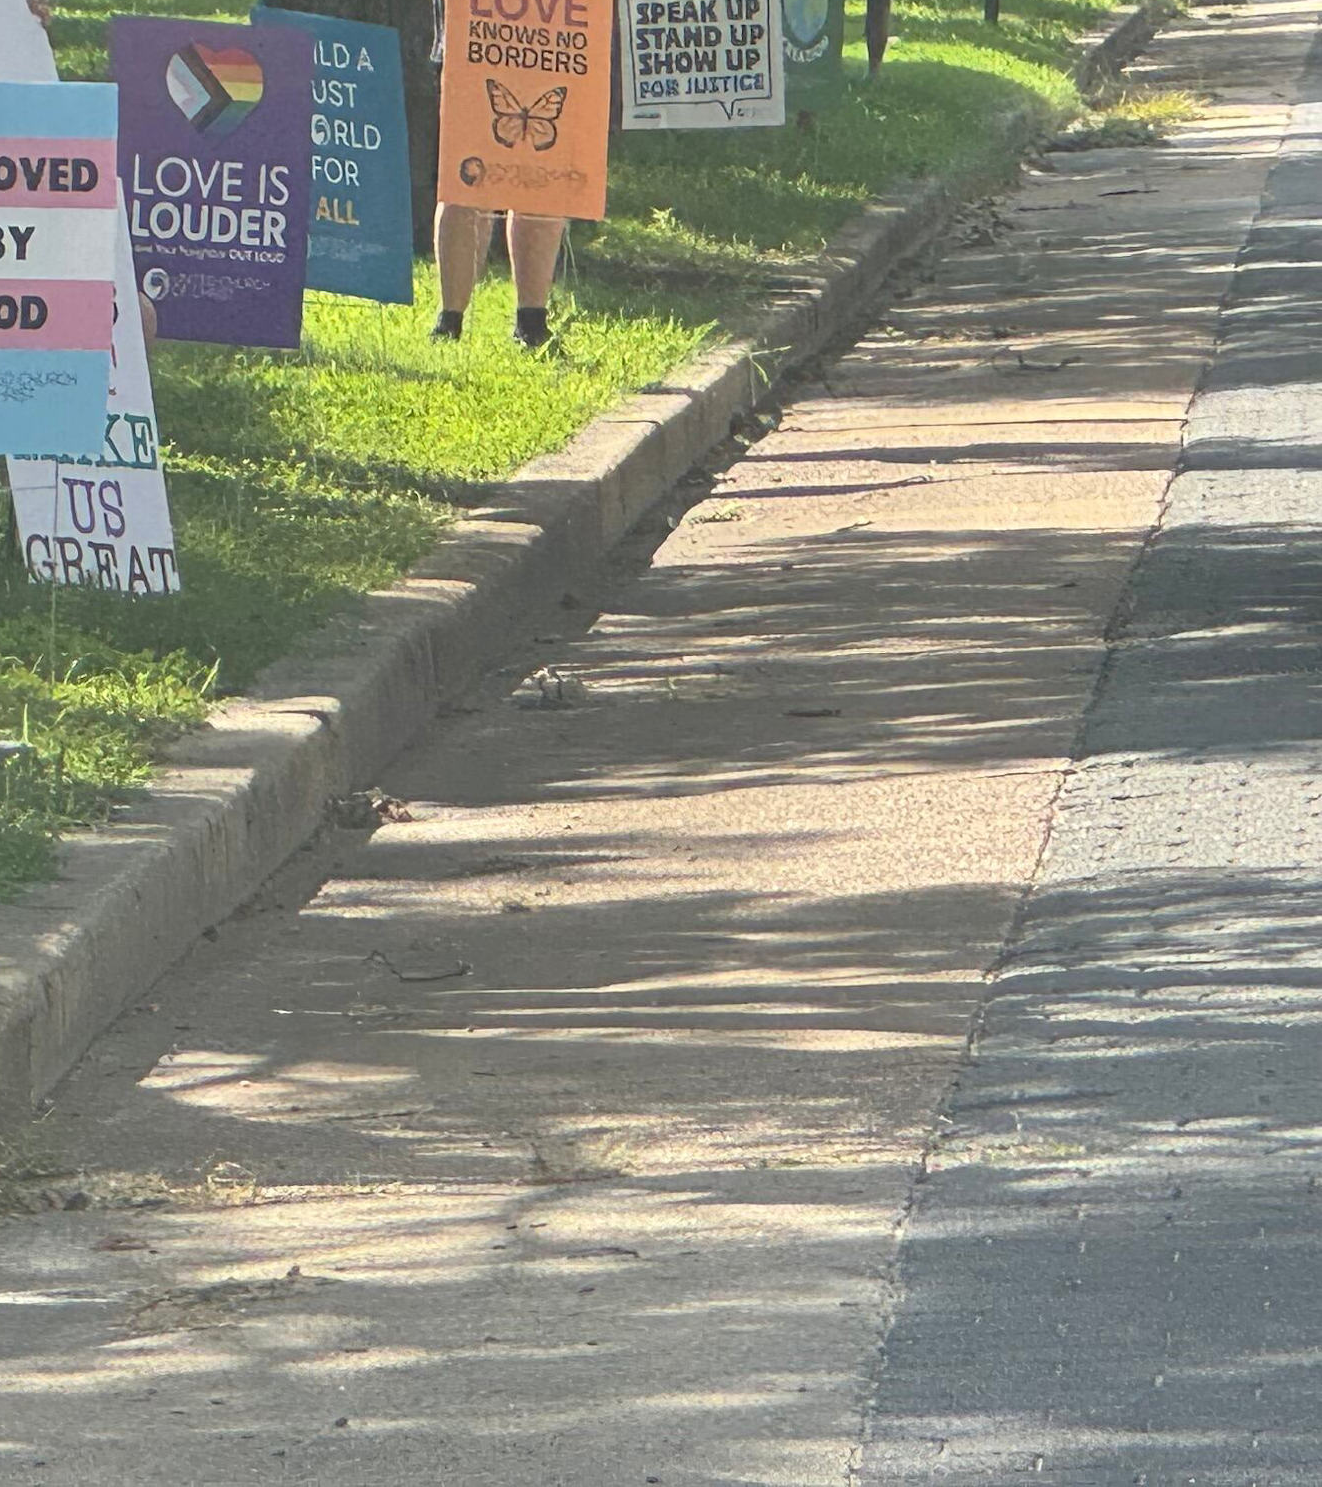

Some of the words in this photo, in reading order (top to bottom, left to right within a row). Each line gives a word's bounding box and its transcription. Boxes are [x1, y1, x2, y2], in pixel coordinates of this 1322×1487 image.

[636, 0, 717, 25] SPEAK
[469, 20, 550, 46] KNOWS
[556, 31, 588, 50] NO
[636, 25, 722, 51] STAND
[730, 24, 765, 46] UP
[313, 41, 350, 69] ILD
[356, 46, 374, 72] A
[468, 41, 588, 75] BORDERS
[639, 49, 717, 75] SHOW
[726, 48, 761, 71] UP
[311, 79, 357, 108] UST
[640, 78, 680, 99] FOR
[685, 73, 764, 95] JUSTICE
[134, 153, 244, 202] LOVE
[259, 163, 290, 206] IS
[312, 155, 360, 187] FOR
[132, 199, 288, 248] LOUDER
[315, 195, 360, 226] ALL
[62, 477, 126, 538] US
[25, 533, 178, 594] GREAT
